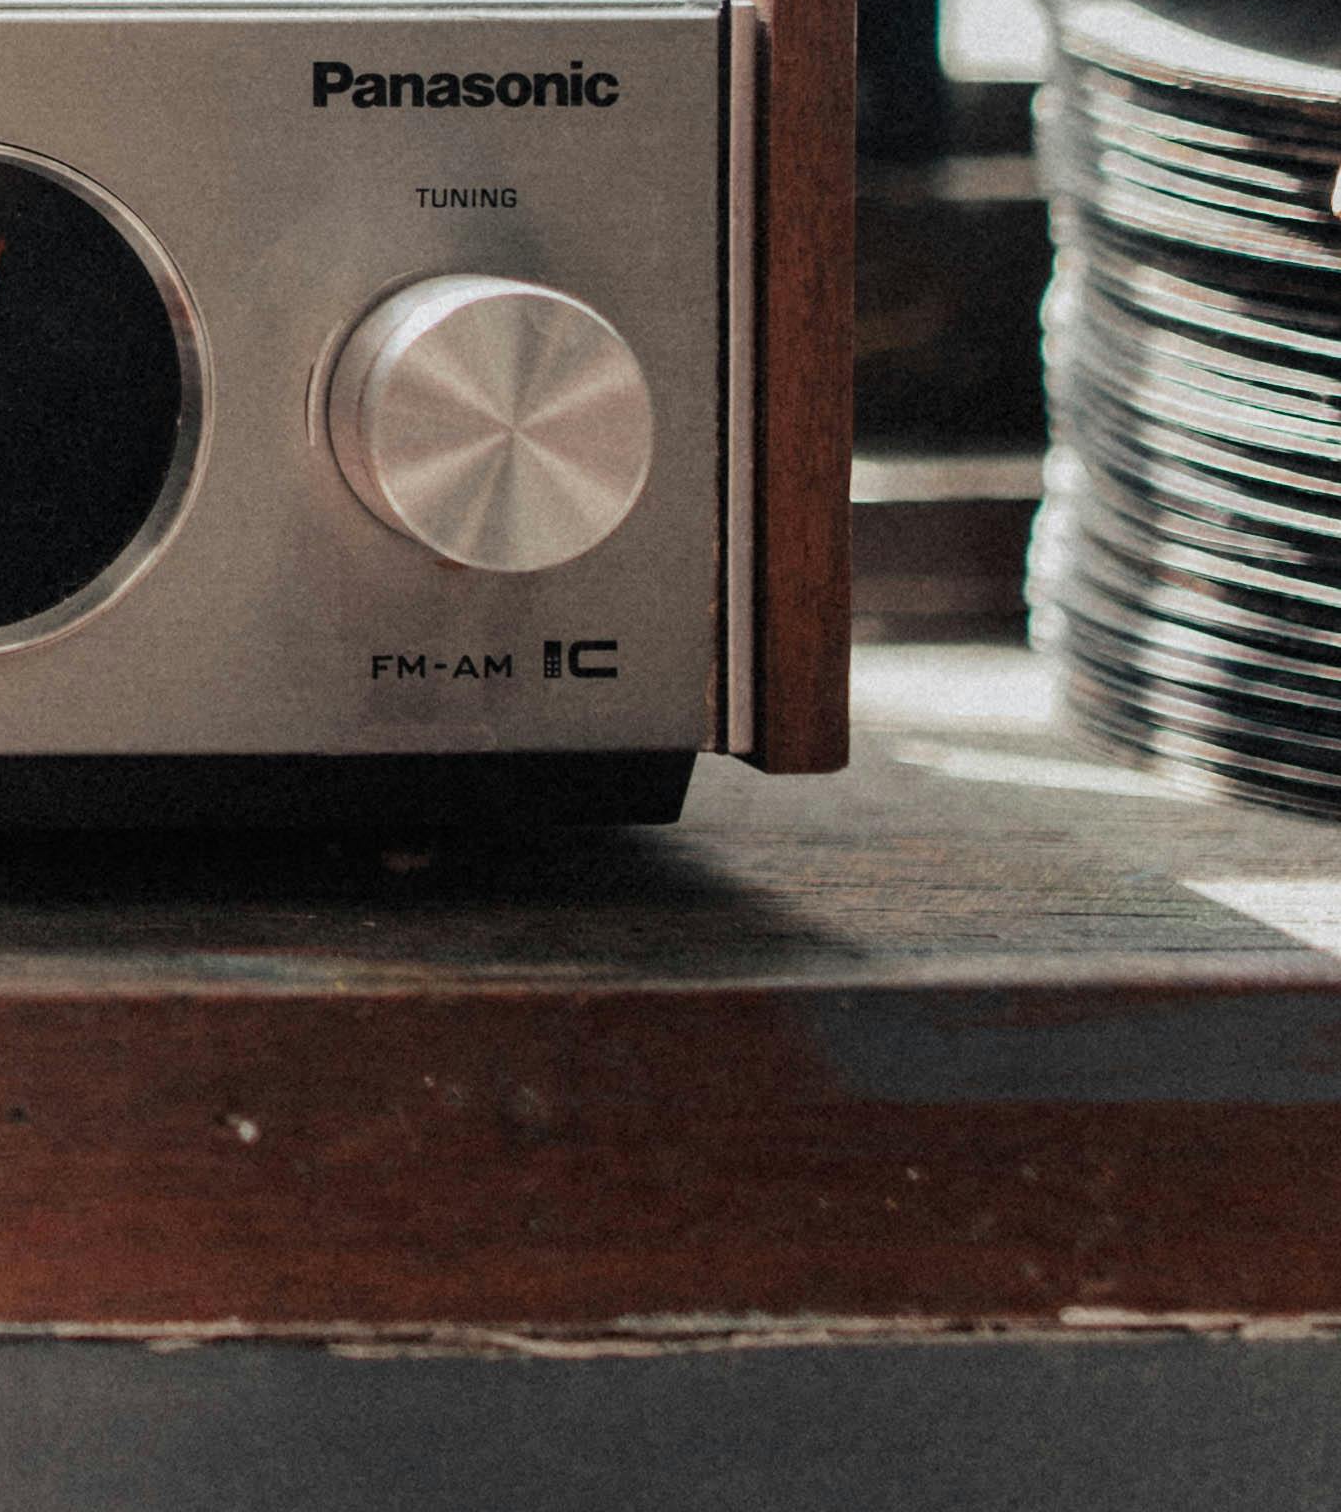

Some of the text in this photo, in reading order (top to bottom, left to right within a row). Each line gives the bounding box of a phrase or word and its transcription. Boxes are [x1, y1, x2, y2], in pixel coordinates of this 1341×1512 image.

[313, 60, 619, 109] Panasonic
[415, 187, 518, 209] TUNING
[370, 640, 618, 680] FM-AM IC
